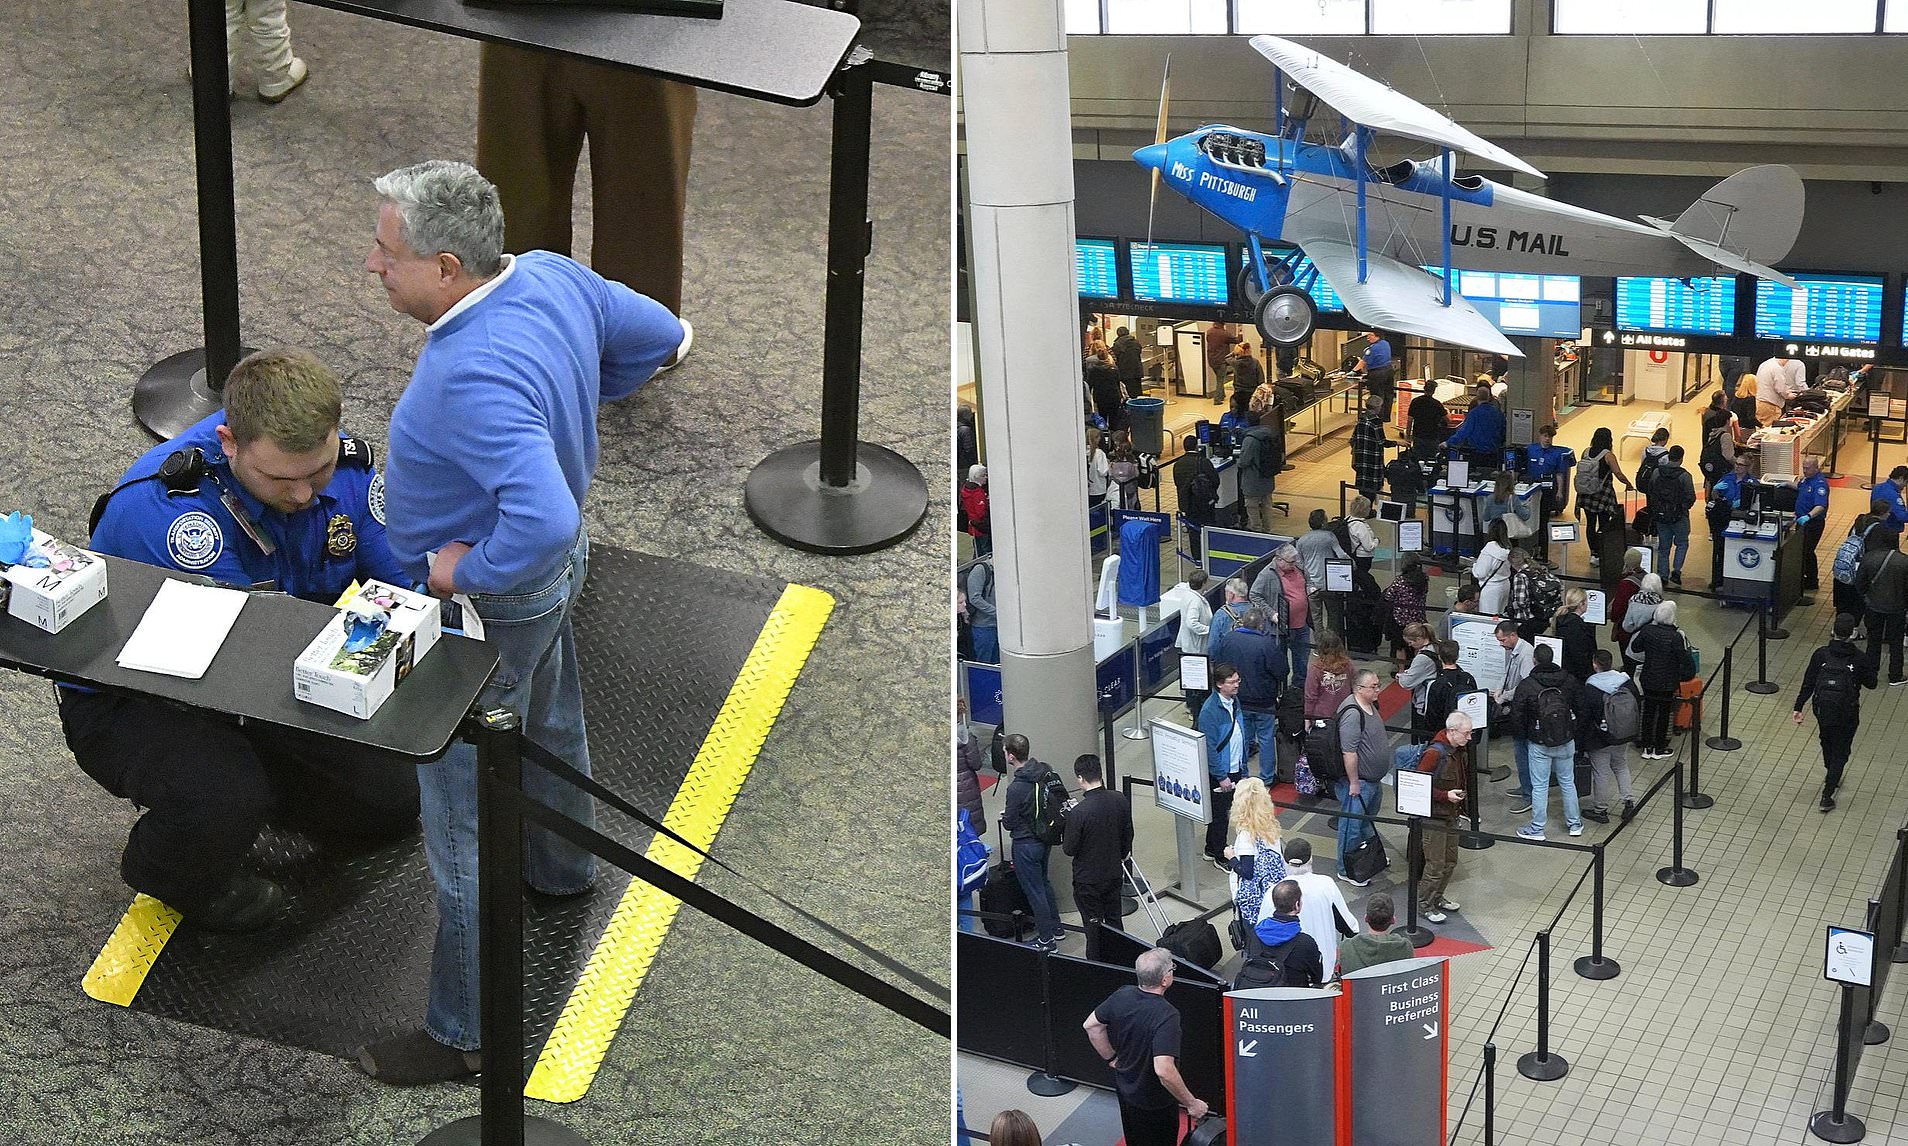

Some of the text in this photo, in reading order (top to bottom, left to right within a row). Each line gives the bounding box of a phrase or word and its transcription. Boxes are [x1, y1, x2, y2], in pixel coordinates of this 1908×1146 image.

[1450, 224, 1569, 257] U.S. MAIL
[1635, 334, 1685, 347] All Gates
[1821, 345, 1875, 358] All Gates
[342, 438, 358, 457] TSA
[36, 575, 62, 591] M
[98, 586, 105, 598] M
[38, 615, 48, 627] M
[353, 705, 360, 715] L
[1380, 974, 1439, 996] First Class
[1389, 991, 1439, 1012] Business
[1239, 1007, 1258, 1020] All
[1384, 1002, 1439, 1026] Preferred
[1239, 1020, 1315, 1036] Passengers
